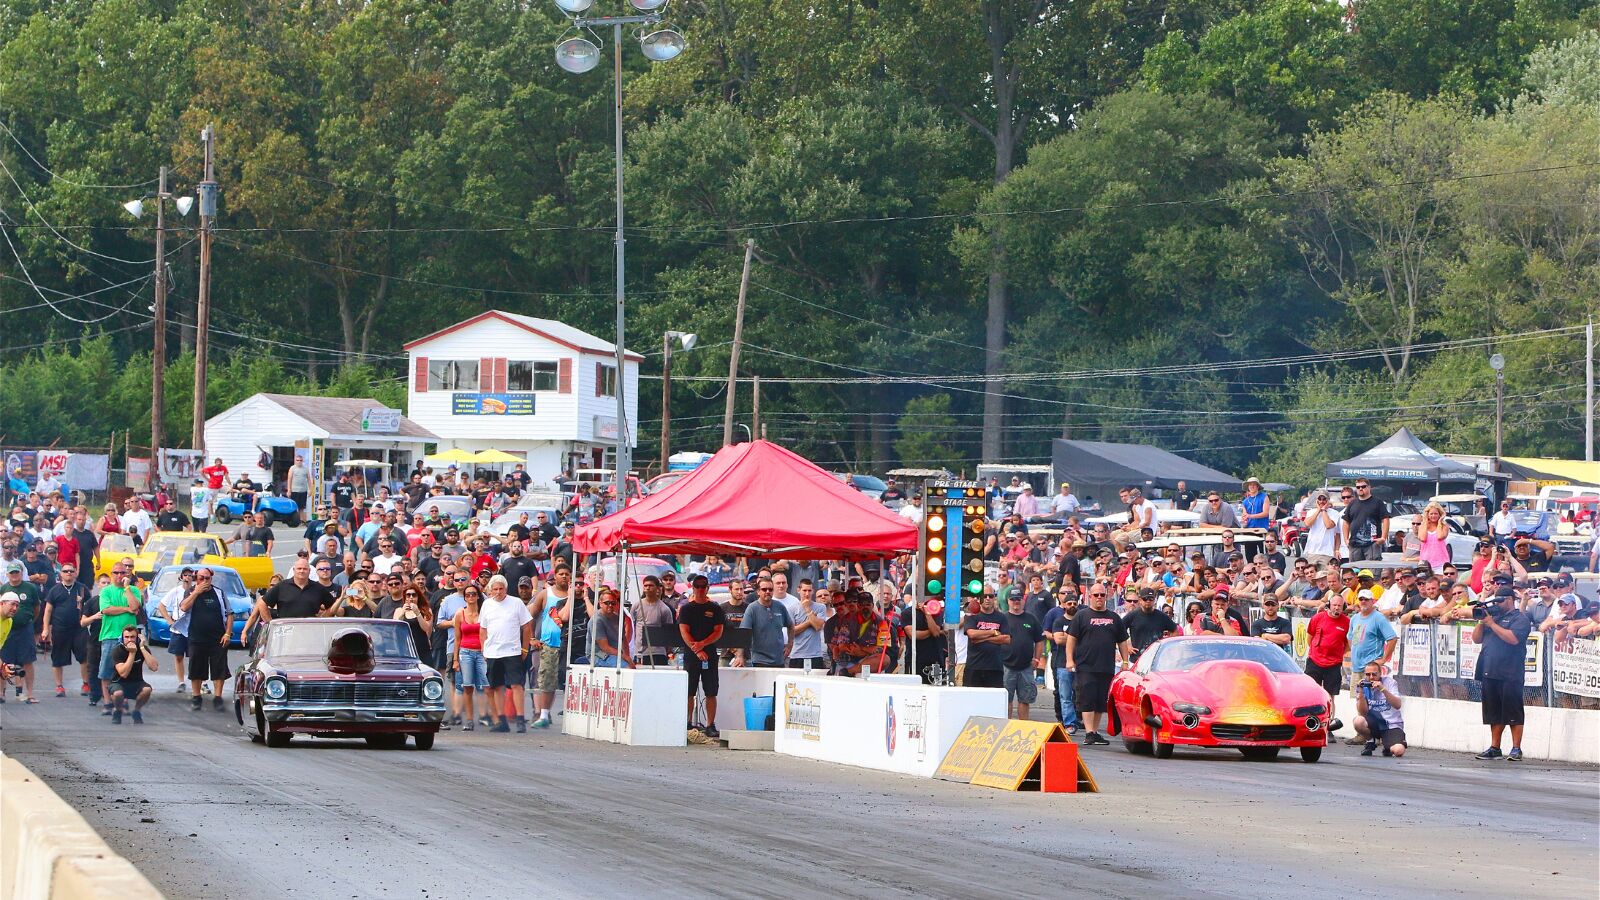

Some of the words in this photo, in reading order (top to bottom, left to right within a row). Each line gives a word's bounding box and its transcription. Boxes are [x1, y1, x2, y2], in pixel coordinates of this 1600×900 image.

[40, 455, 67, 470] MSD
[1341, 468, 1384, 477] TRACTION
[1387, 470, 1429, 479] CONTROL
[934, 480, 978, 488] PRE-STAGE
[943, 498, 968, 506] STAGE
[581, 674, 603, 728] Conty
[602, 676, 632, 732] Draway
